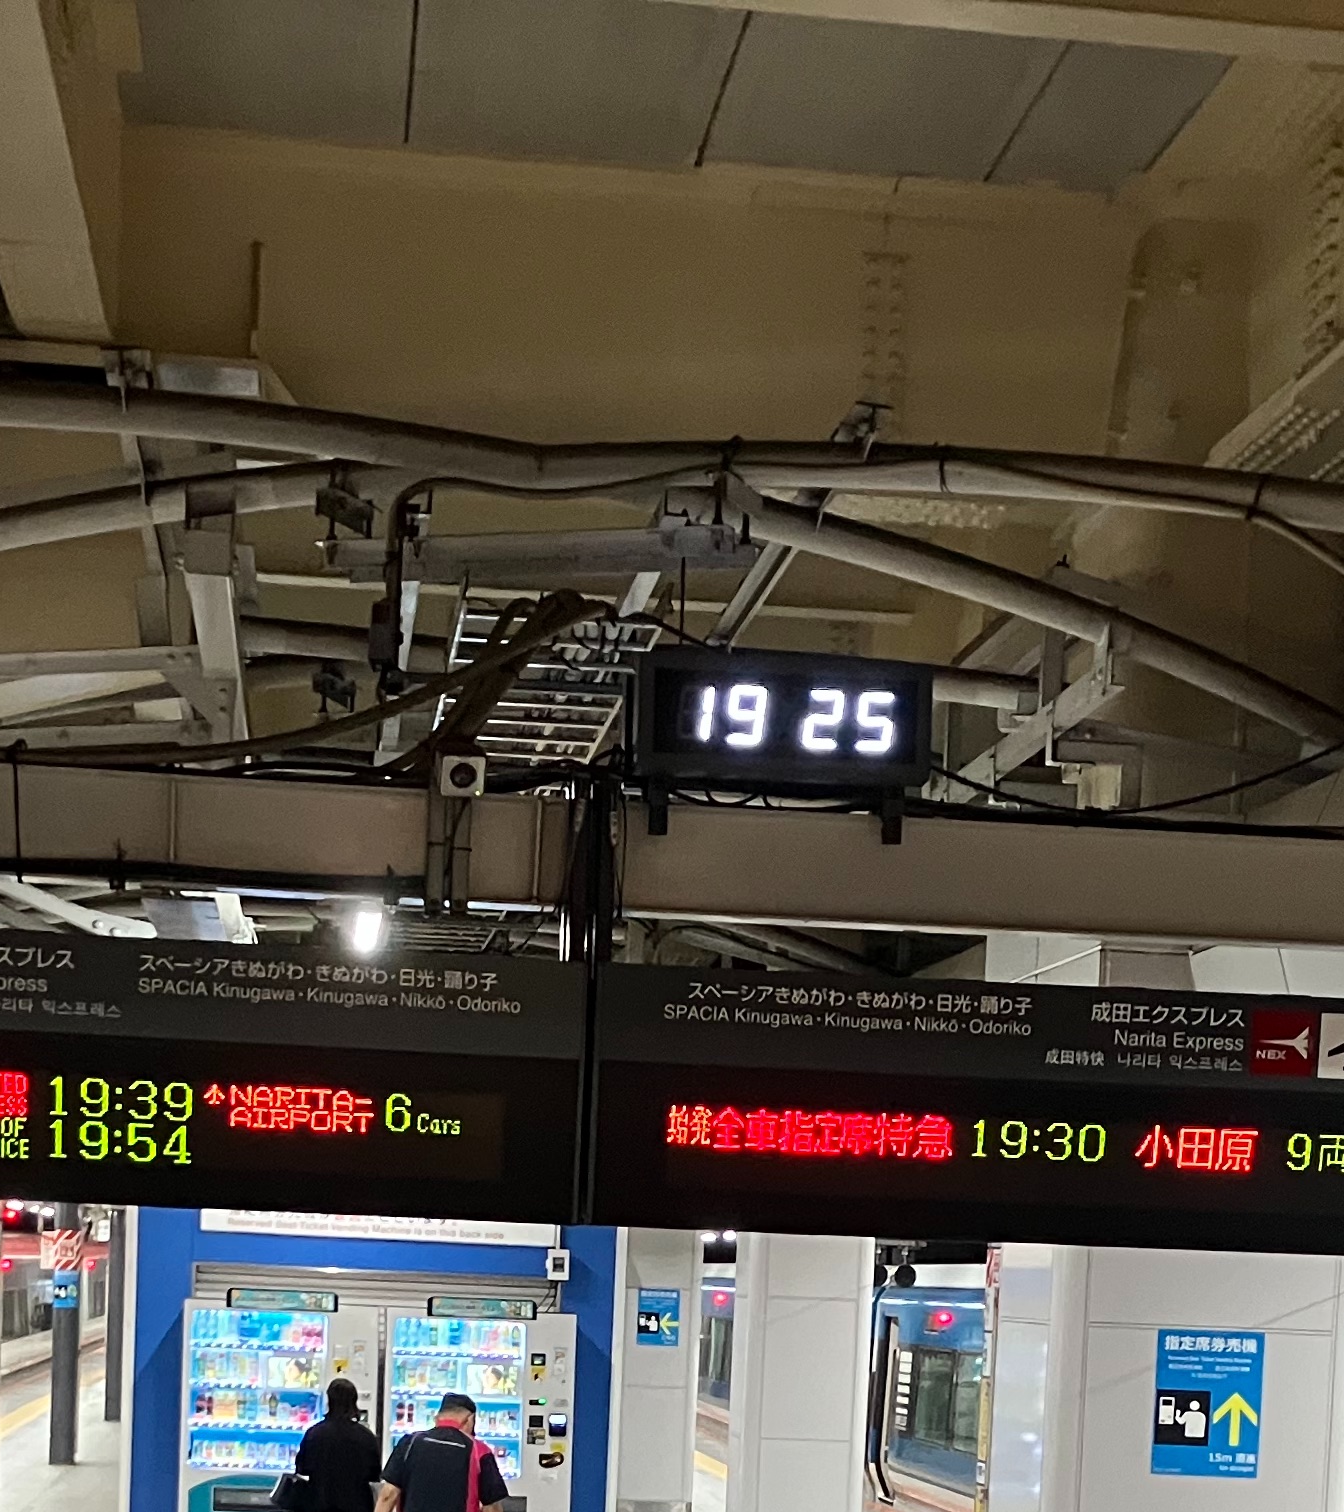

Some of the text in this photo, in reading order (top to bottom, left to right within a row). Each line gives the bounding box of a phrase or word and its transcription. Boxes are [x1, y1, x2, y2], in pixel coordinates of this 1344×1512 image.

[697, 683, 896, 753] 19 25
[138, 978, 208, 997] SPACIA
[664, 1004, 729, 1023] SPACIA
[1091, 1002, 1245, 1029] 成田エクスプレス
[1114, 1029, 1244, 1054] Narita Express
[49, 1076, 194, 1122] 19:39
[385, 1092, 461, 1135] 6 Cars
[0, 1118, 26, 1138] OF
[229, 1107, 374, 1133] AIRPORT
[49, 1118, 192, 1165] 19:54
[971, 1119, 1107, 1162] 19:30
[1134, 1124, 1259, 1172] 小田原
